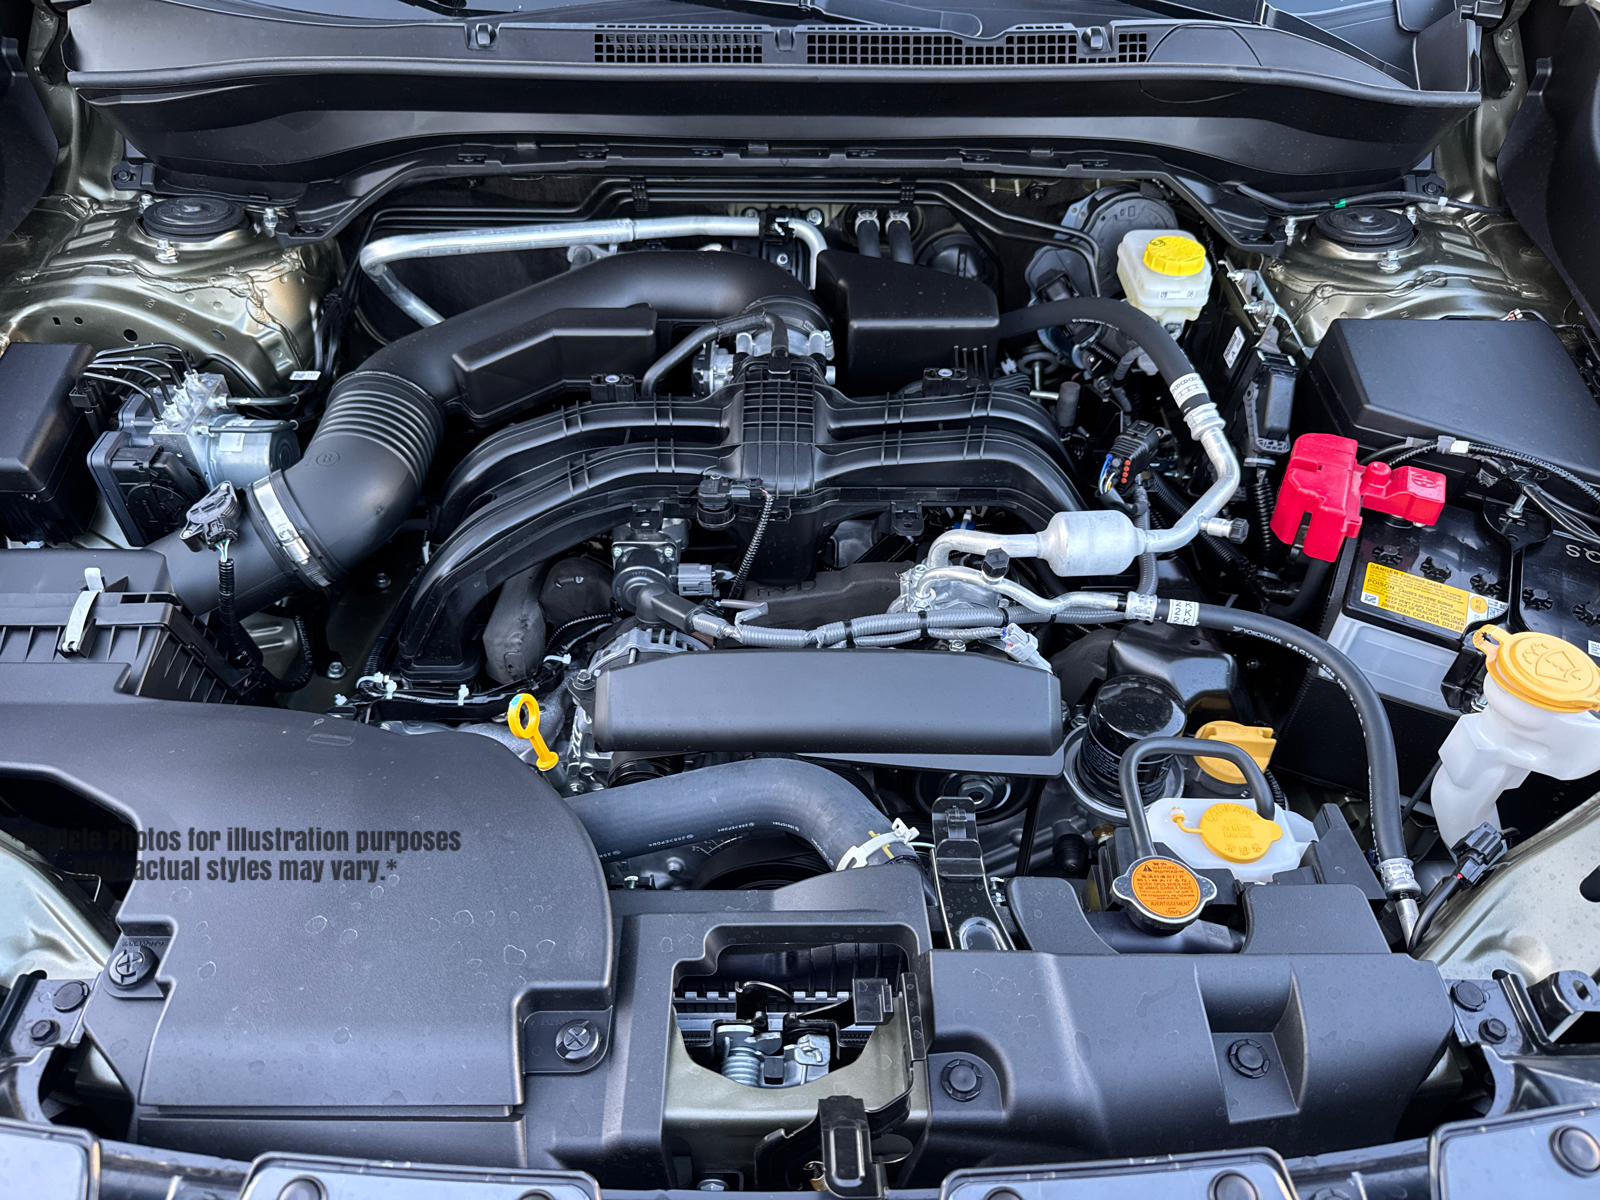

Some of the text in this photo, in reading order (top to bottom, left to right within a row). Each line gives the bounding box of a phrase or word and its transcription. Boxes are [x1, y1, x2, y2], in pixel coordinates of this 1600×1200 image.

[1367, 578, 1395, 591] POISON
[1243, 628, 1282, 645] YOKOHAMA
[1205, 803, 1260, 822] COOLANT
